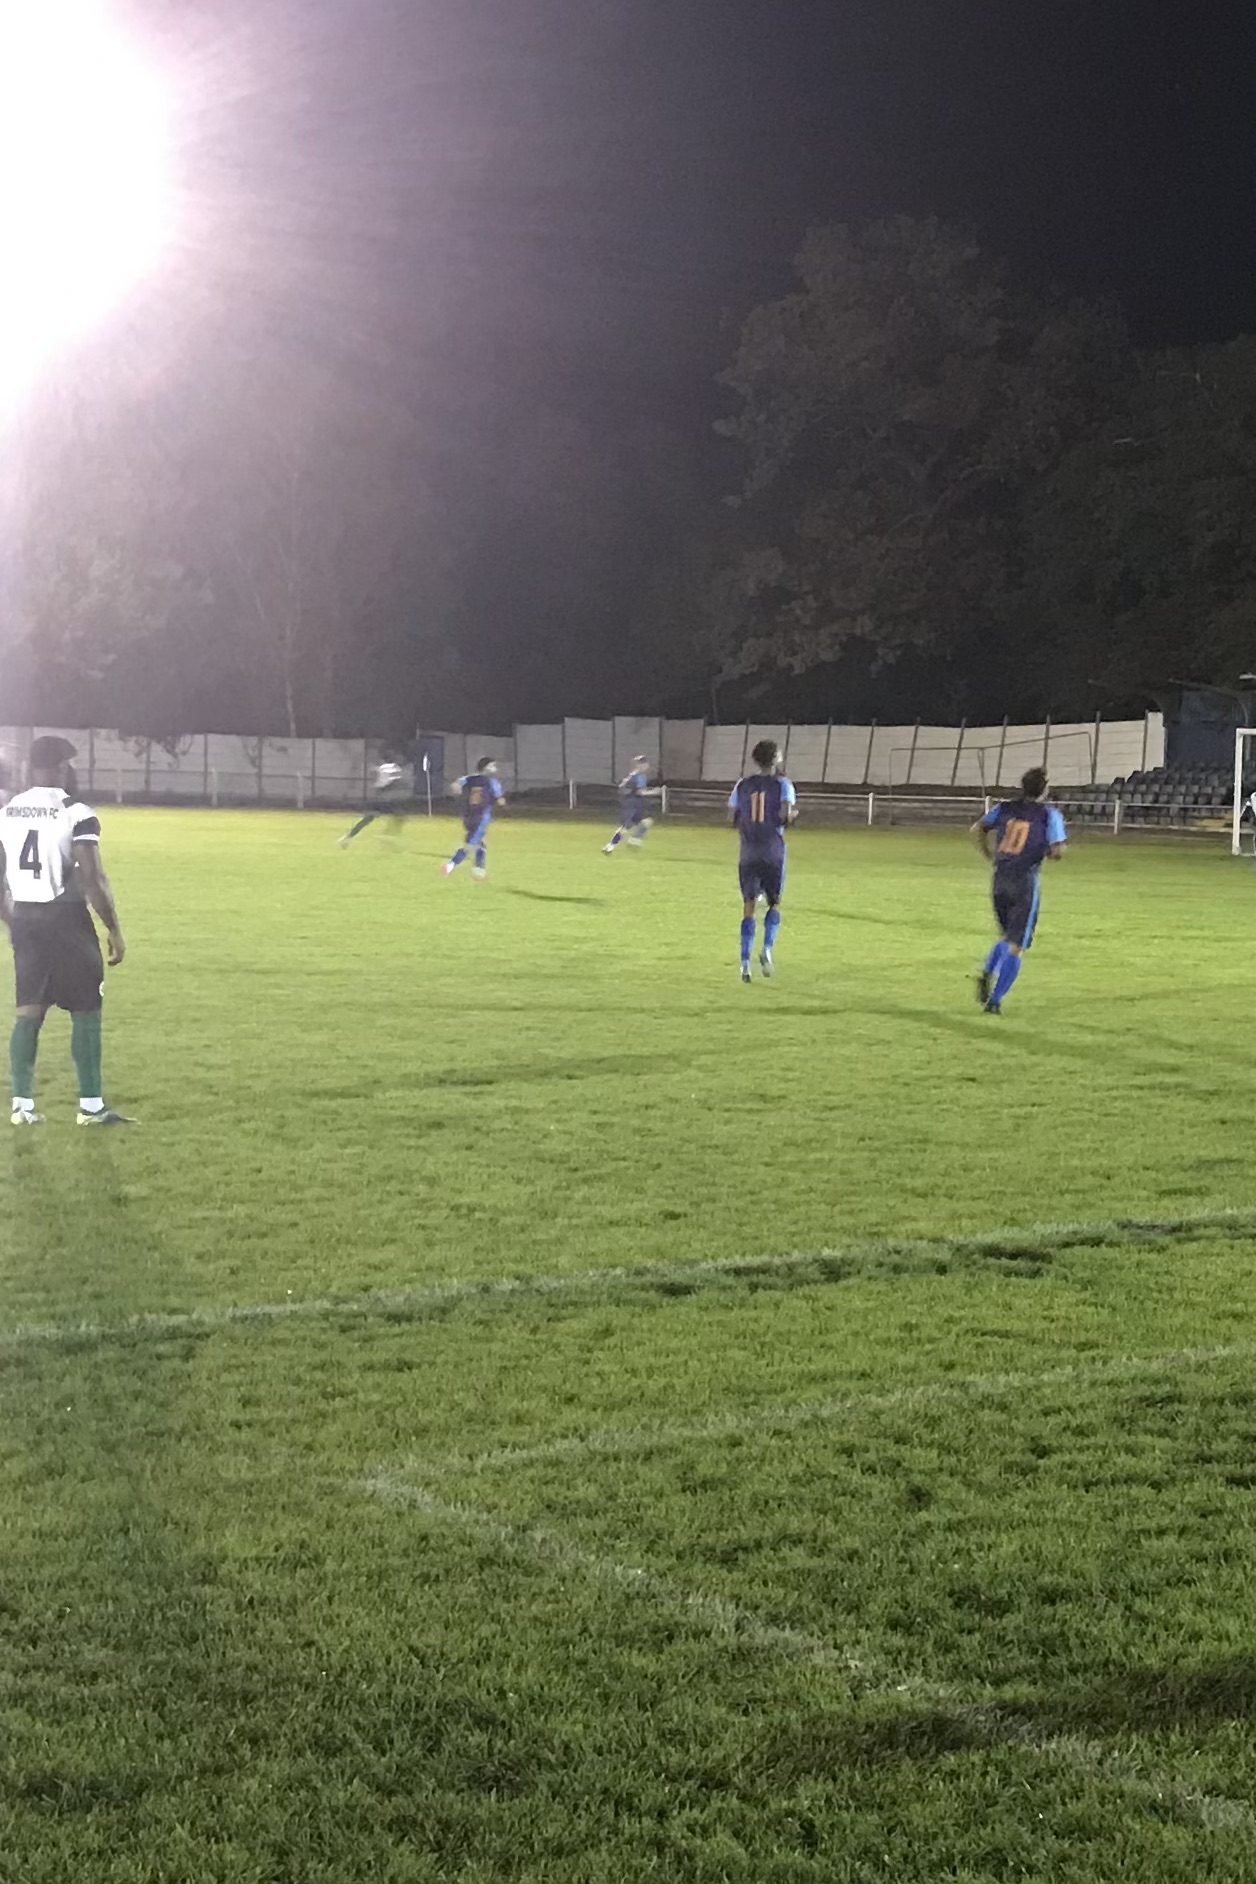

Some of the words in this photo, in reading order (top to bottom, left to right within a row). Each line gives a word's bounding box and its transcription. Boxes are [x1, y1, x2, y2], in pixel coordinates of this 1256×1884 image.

[49, 807, 59, 819] FC
[751, 791, 765, 822] 11
[1000, 818, 1030, 855] 10
[19, 829, 42, 879] 4
